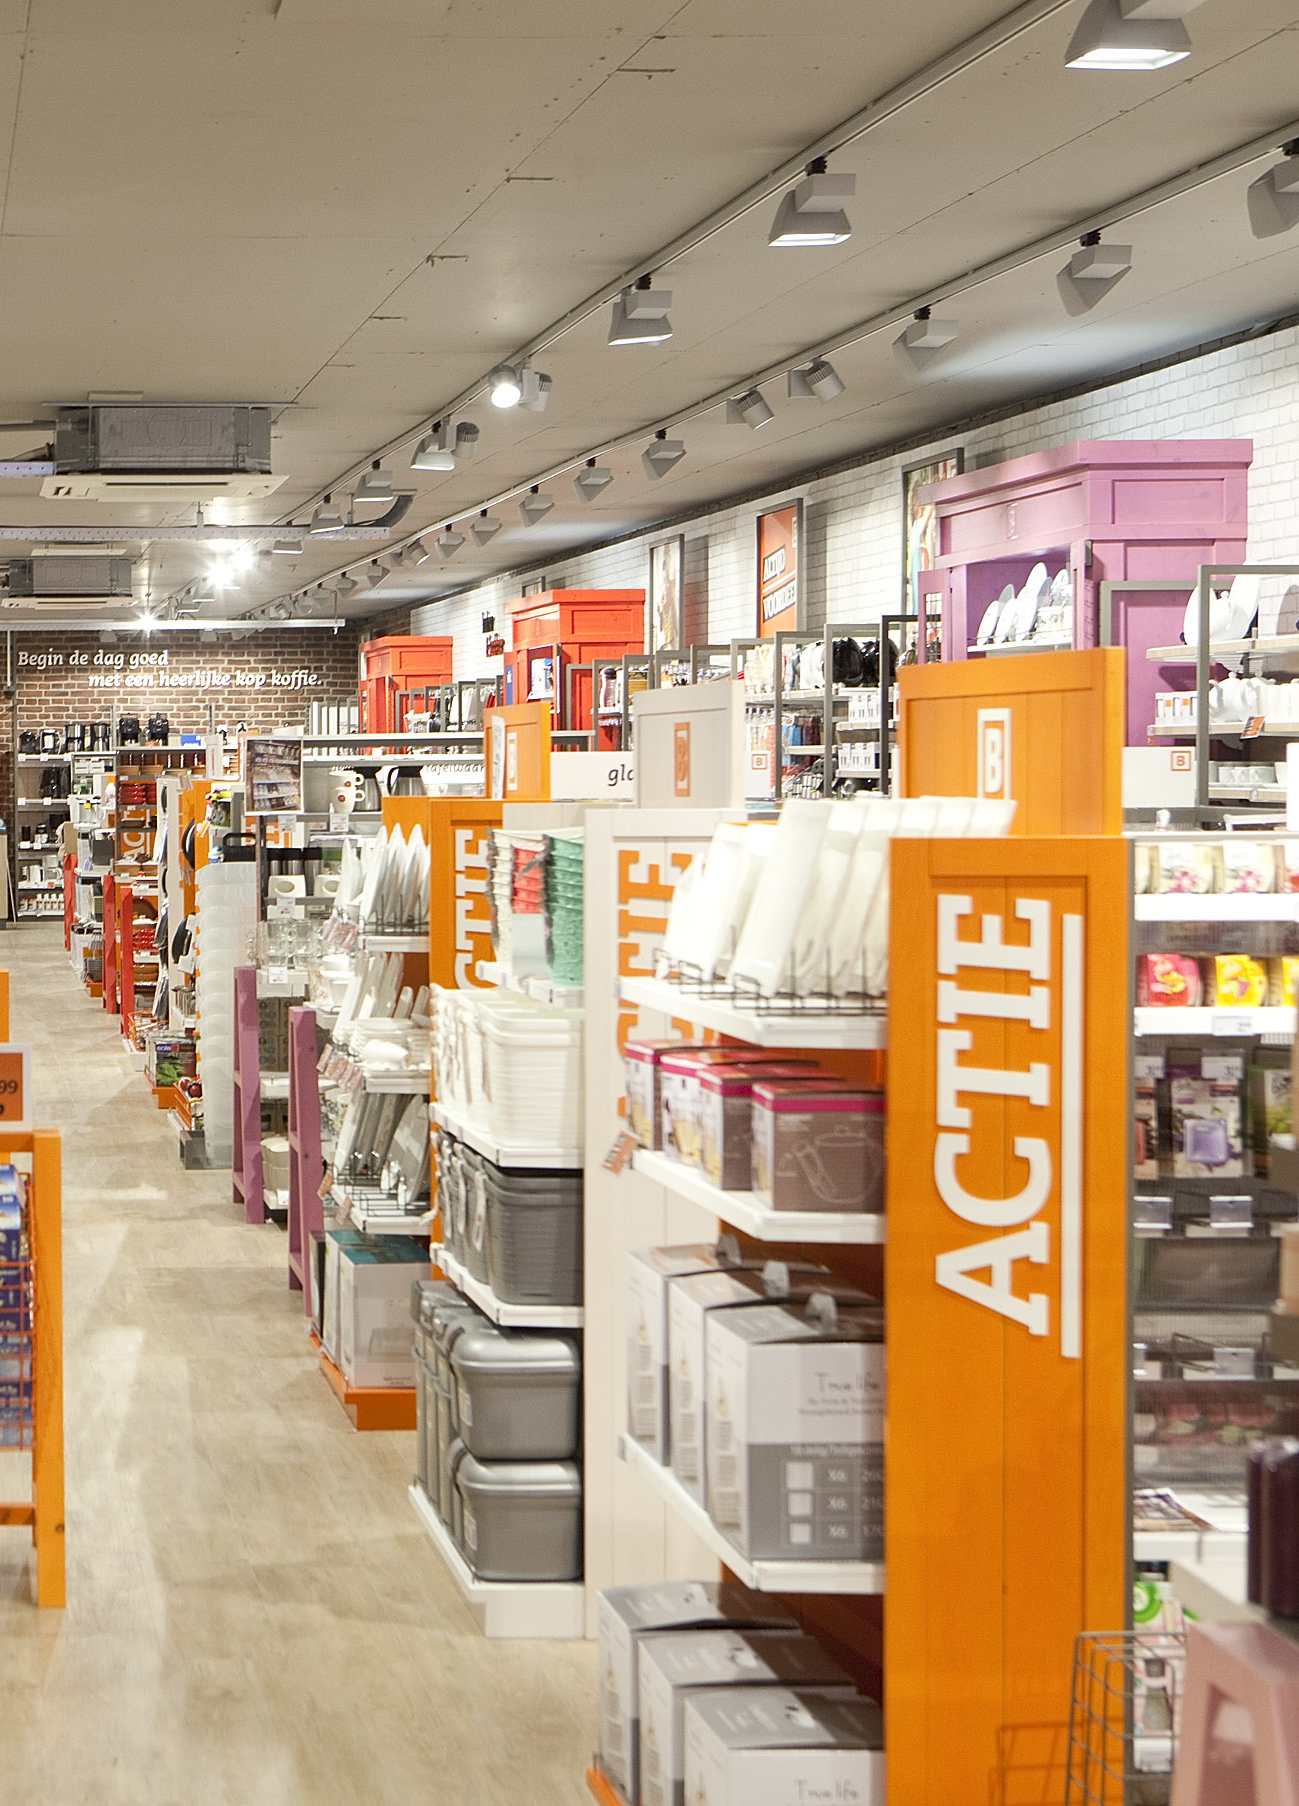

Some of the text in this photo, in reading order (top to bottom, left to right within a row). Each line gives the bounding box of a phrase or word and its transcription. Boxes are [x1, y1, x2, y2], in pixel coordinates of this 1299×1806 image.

[17, 648, 169, 670] Begin de dag goed
[88, 669, 323, 692] met een heerlijke kop koffie.
[1176, 756, 1186, 766] B
[933, 893, 1052, 1337] ACTIE
